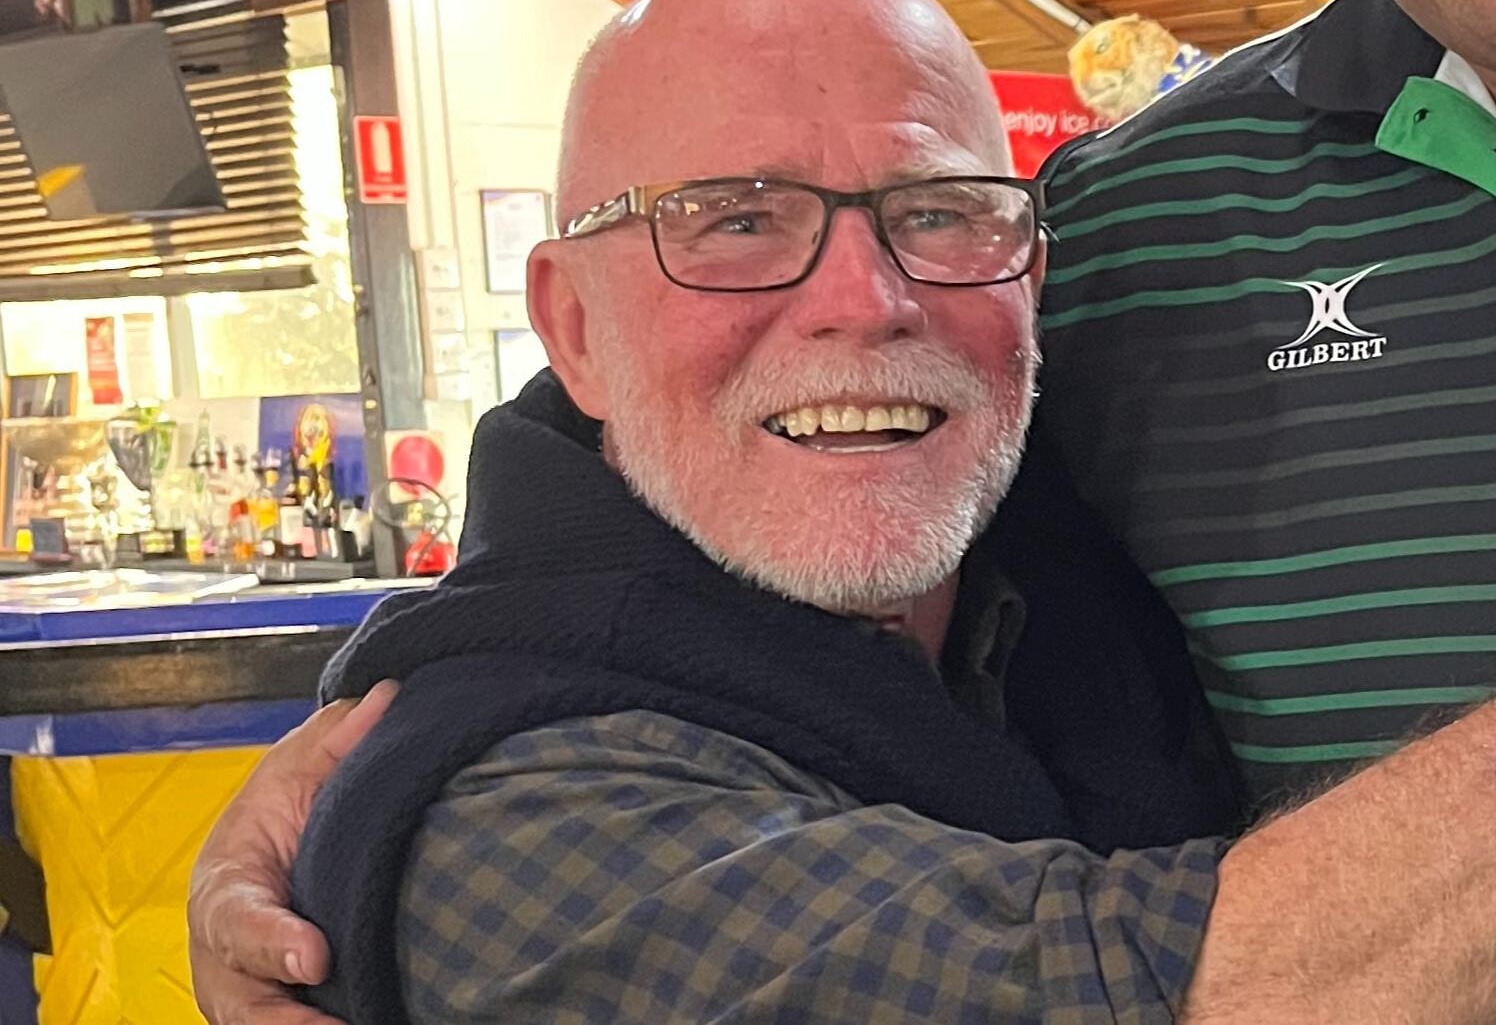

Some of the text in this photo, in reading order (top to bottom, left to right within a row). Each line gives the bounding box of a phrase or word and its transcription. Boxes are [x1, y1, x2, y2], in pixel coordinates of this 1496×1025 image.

[1003, 106, 1057, 137] enjoy
[1060, 109, 1090, 135] ice
[1267, 337, 1388, 371] GILBERT
